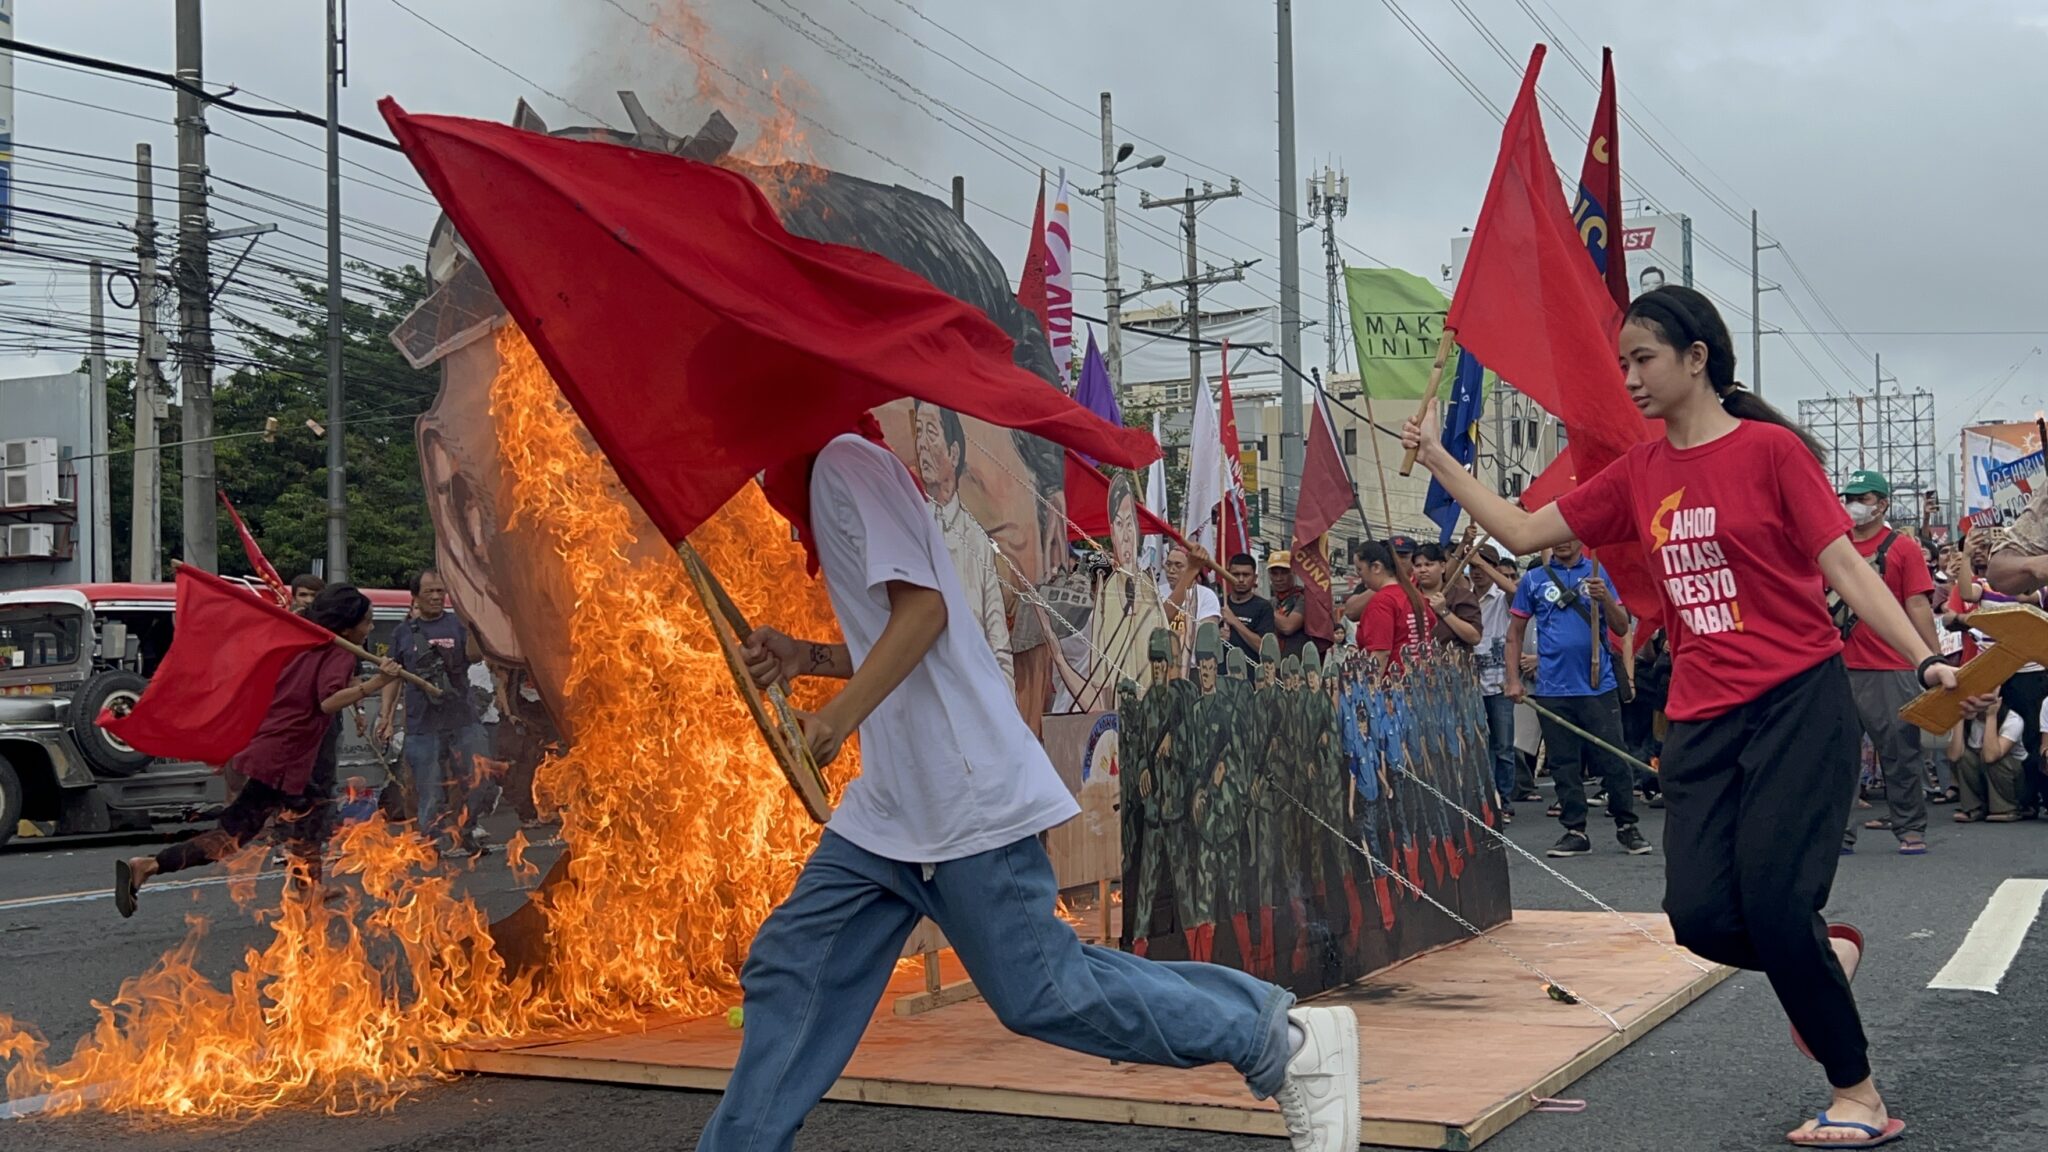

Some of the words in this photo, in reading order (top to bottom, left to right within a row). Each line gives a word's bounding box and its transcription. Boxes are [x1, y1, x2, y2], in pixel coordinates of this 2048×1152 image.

[1366, 315, 1446, 335] MAK
[1367, 337, 1442, 356] INIT
[1294, 549, 1330, 593] GUNA
[1661, 541, 1728, 575] ITAAS!
